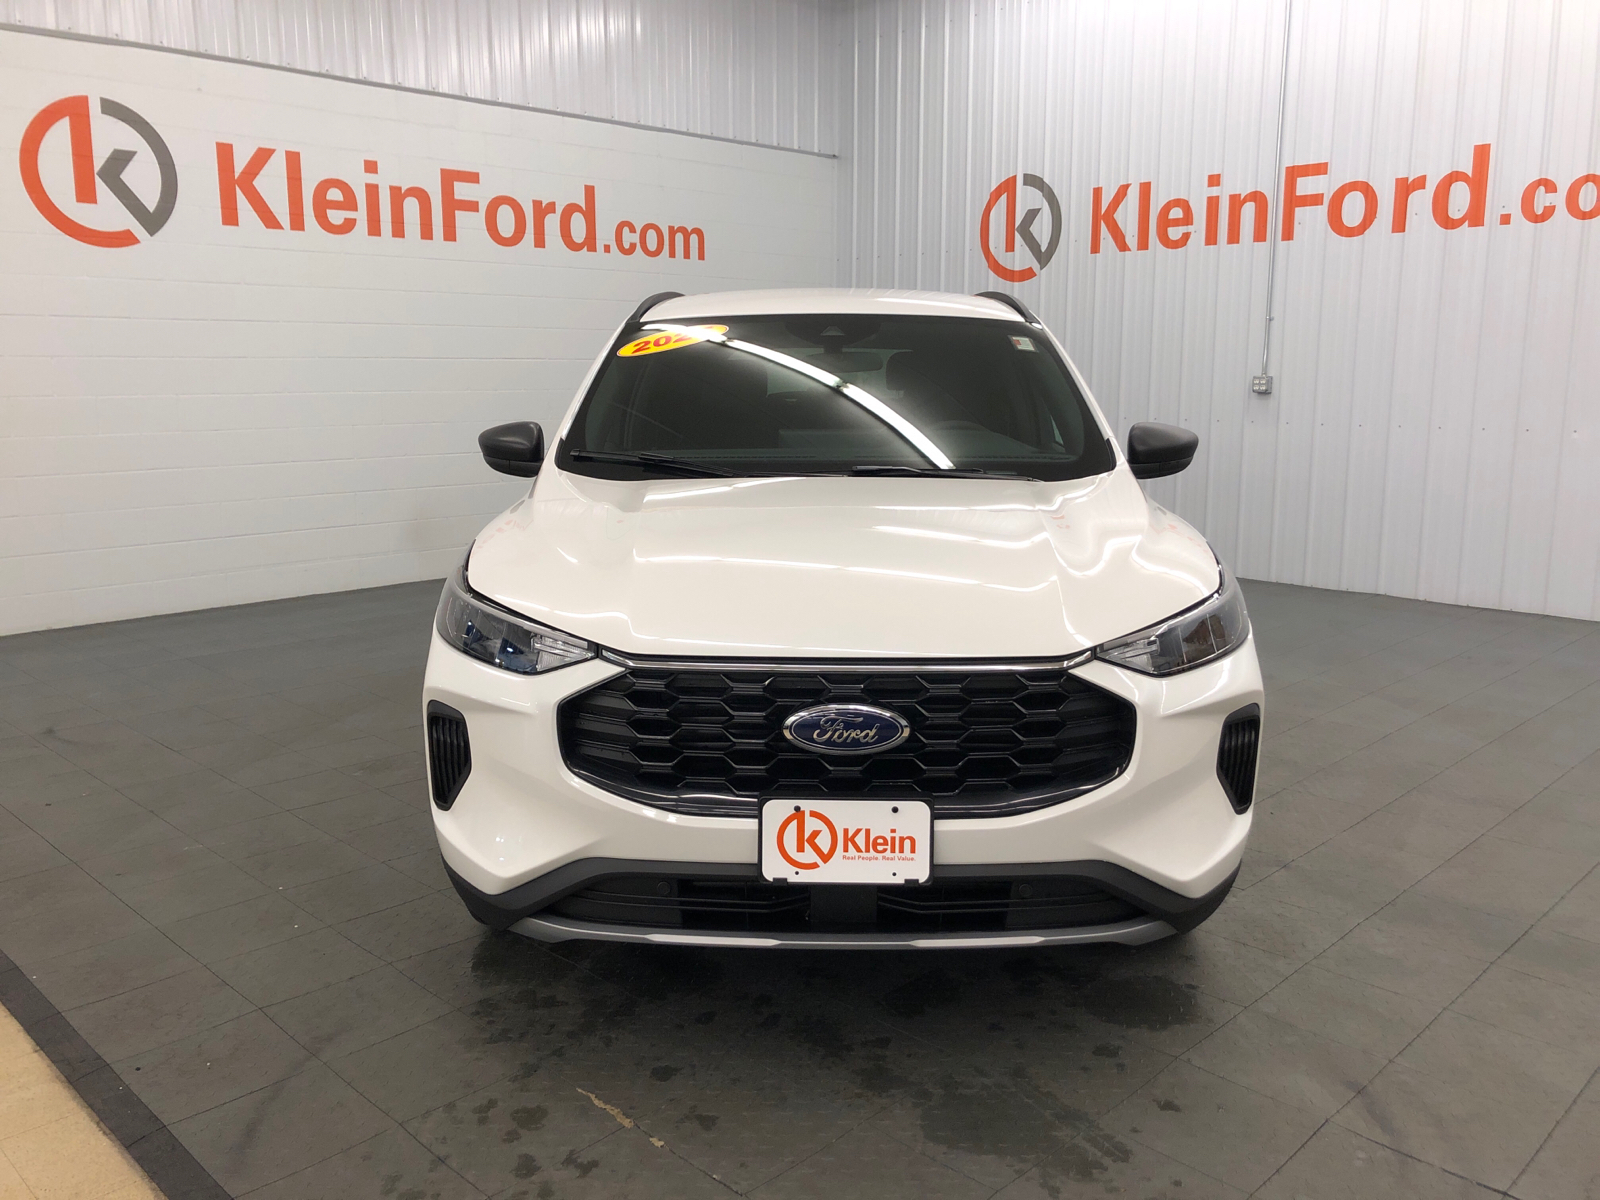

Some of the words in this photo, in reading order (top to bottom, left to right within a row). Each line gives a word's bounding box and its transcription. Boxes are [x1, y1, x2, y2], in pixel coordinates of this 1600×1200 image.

[215, 141, 706, 261] KleinFord.com
[631, 325, 714, 355] 202
[812, 715, 881, 743] Ford
[842, 827, 917, 855] Klein
